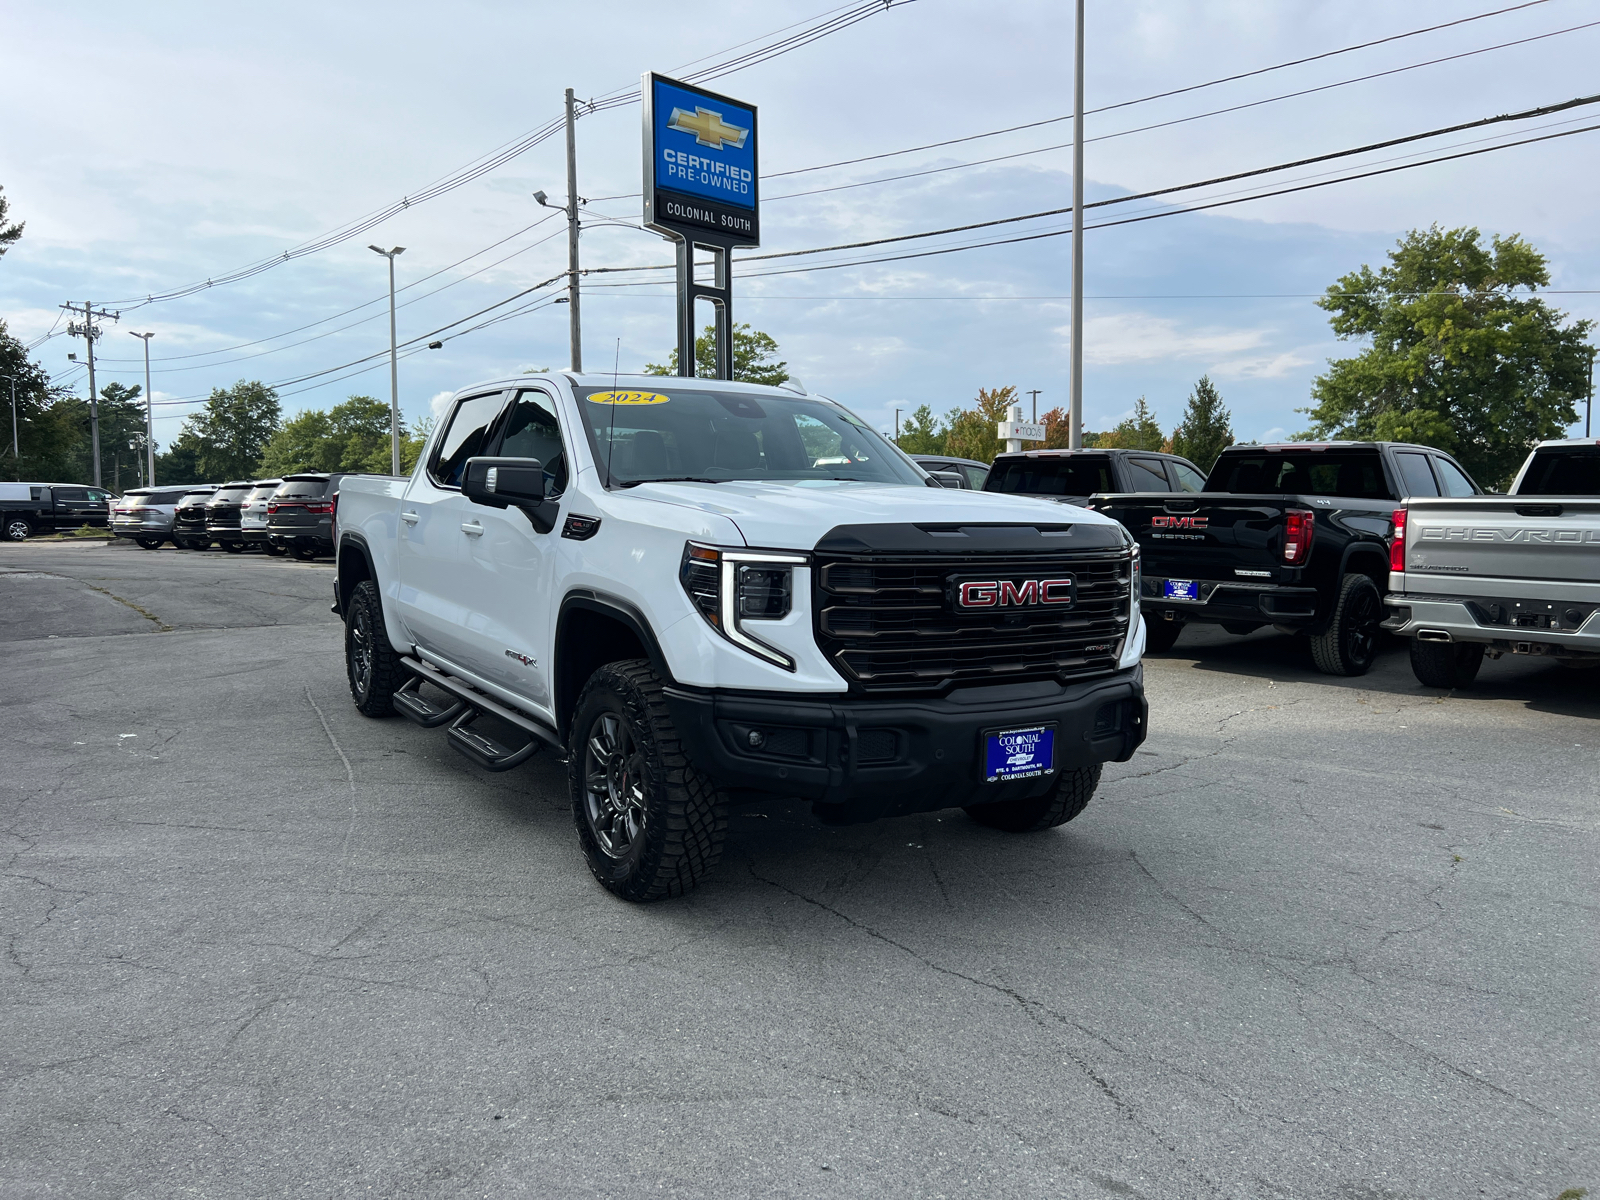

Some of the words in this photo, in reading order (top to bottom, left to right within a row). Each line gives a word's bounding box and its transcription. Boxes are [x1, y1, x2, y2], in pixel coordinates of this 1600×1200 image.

[664, 149, 752, 182] CERTIFIED
[668, 164, 748, 194] PRE-OWNED
[667, 202, 716, 224] COLONIAL
[721, 214, 751, 231] SOUTH
[603, 393, 656, 403] 2024
[1020, 426, 1042, 438] macy's
[1152, 516, 1209, 529] GMC
[959, 578, 1072, 607] GMC
[999, 733, 1041, 746] COLONIAL
[1006, 743, 1034, 754] SOUTH
[1001, 772, 1026, 780] COLONIAL
[1026, 770, 1042, 778] SOUTH
